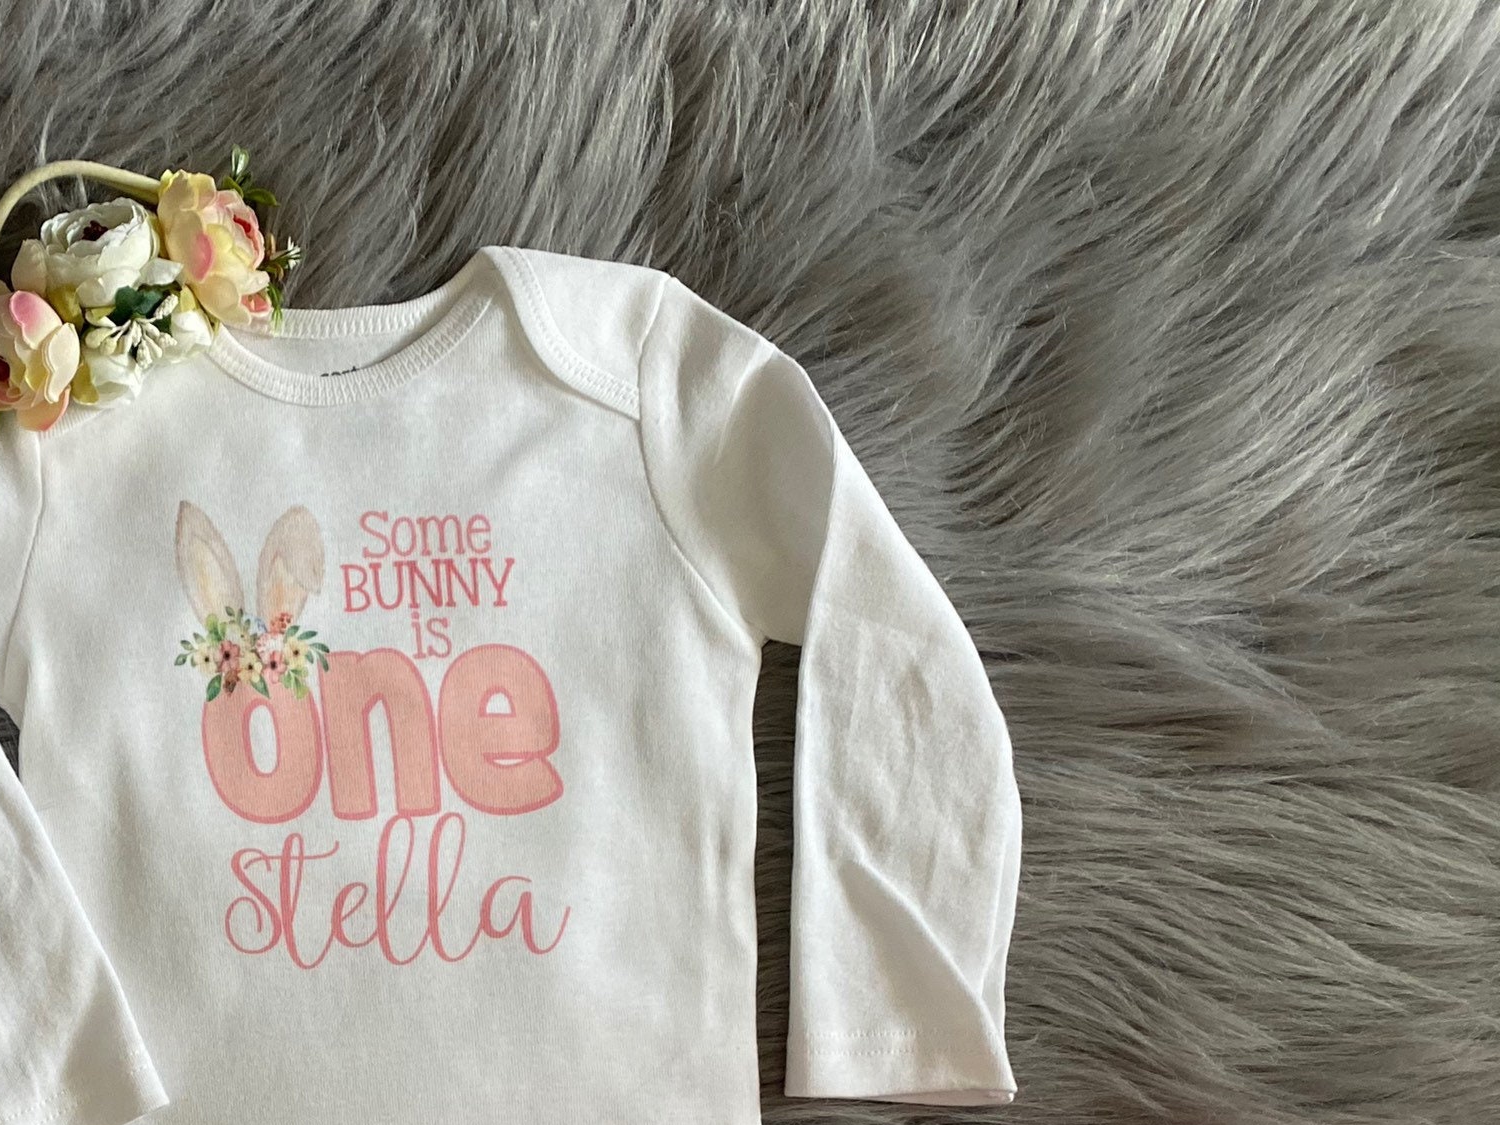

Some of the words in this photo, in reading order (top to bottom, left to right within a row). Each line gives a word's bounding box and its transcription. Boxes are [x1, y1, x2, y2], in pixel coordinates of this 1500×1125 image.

[359, 511, 493, 558] Some
[341, 558, 515, 612] BUNNY
[413, 611, 453, 660] is
[201, 643, 565, 825] one
